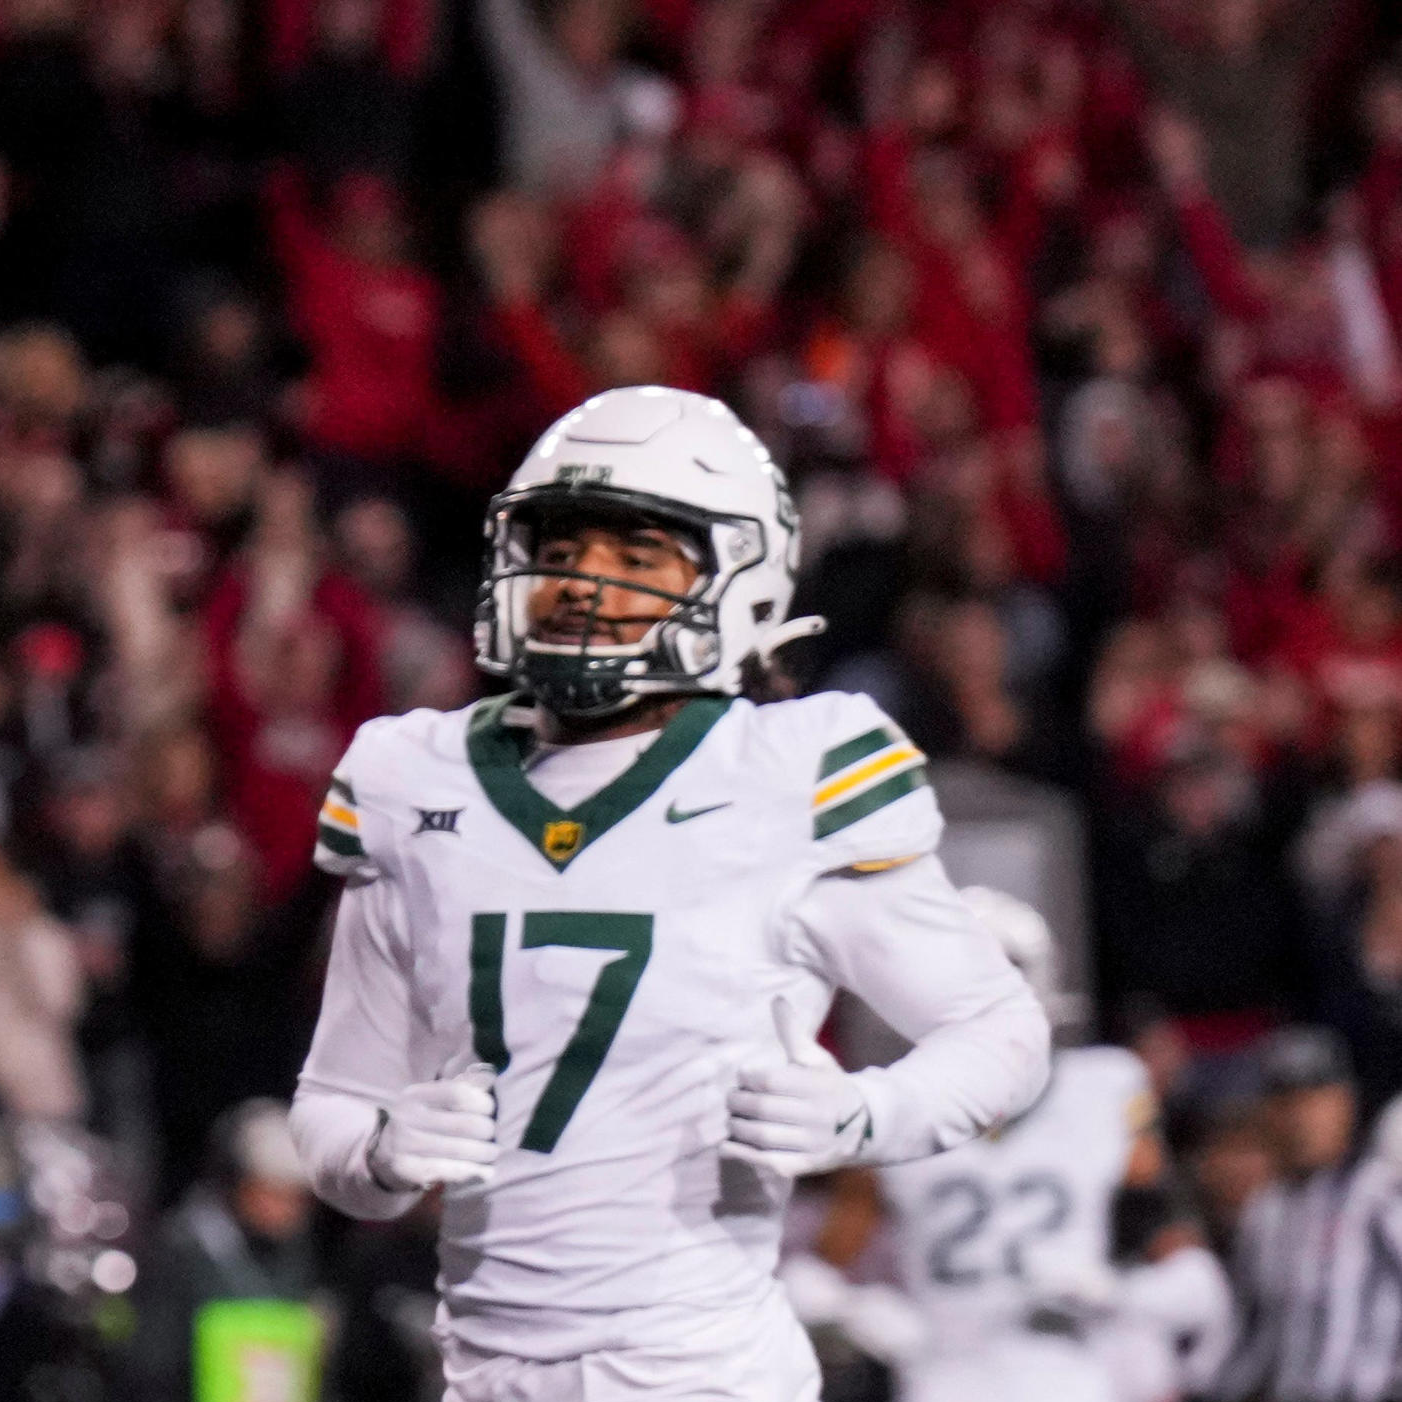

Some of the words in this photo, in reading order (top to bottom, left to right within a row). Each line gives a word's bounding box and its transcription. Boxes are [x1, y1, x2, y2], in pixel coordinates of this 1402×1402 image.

[410, 806, 468, 836] XII
[468, 911, 655, 1154] 17
[923, 1172, 1073, 1286] 22
